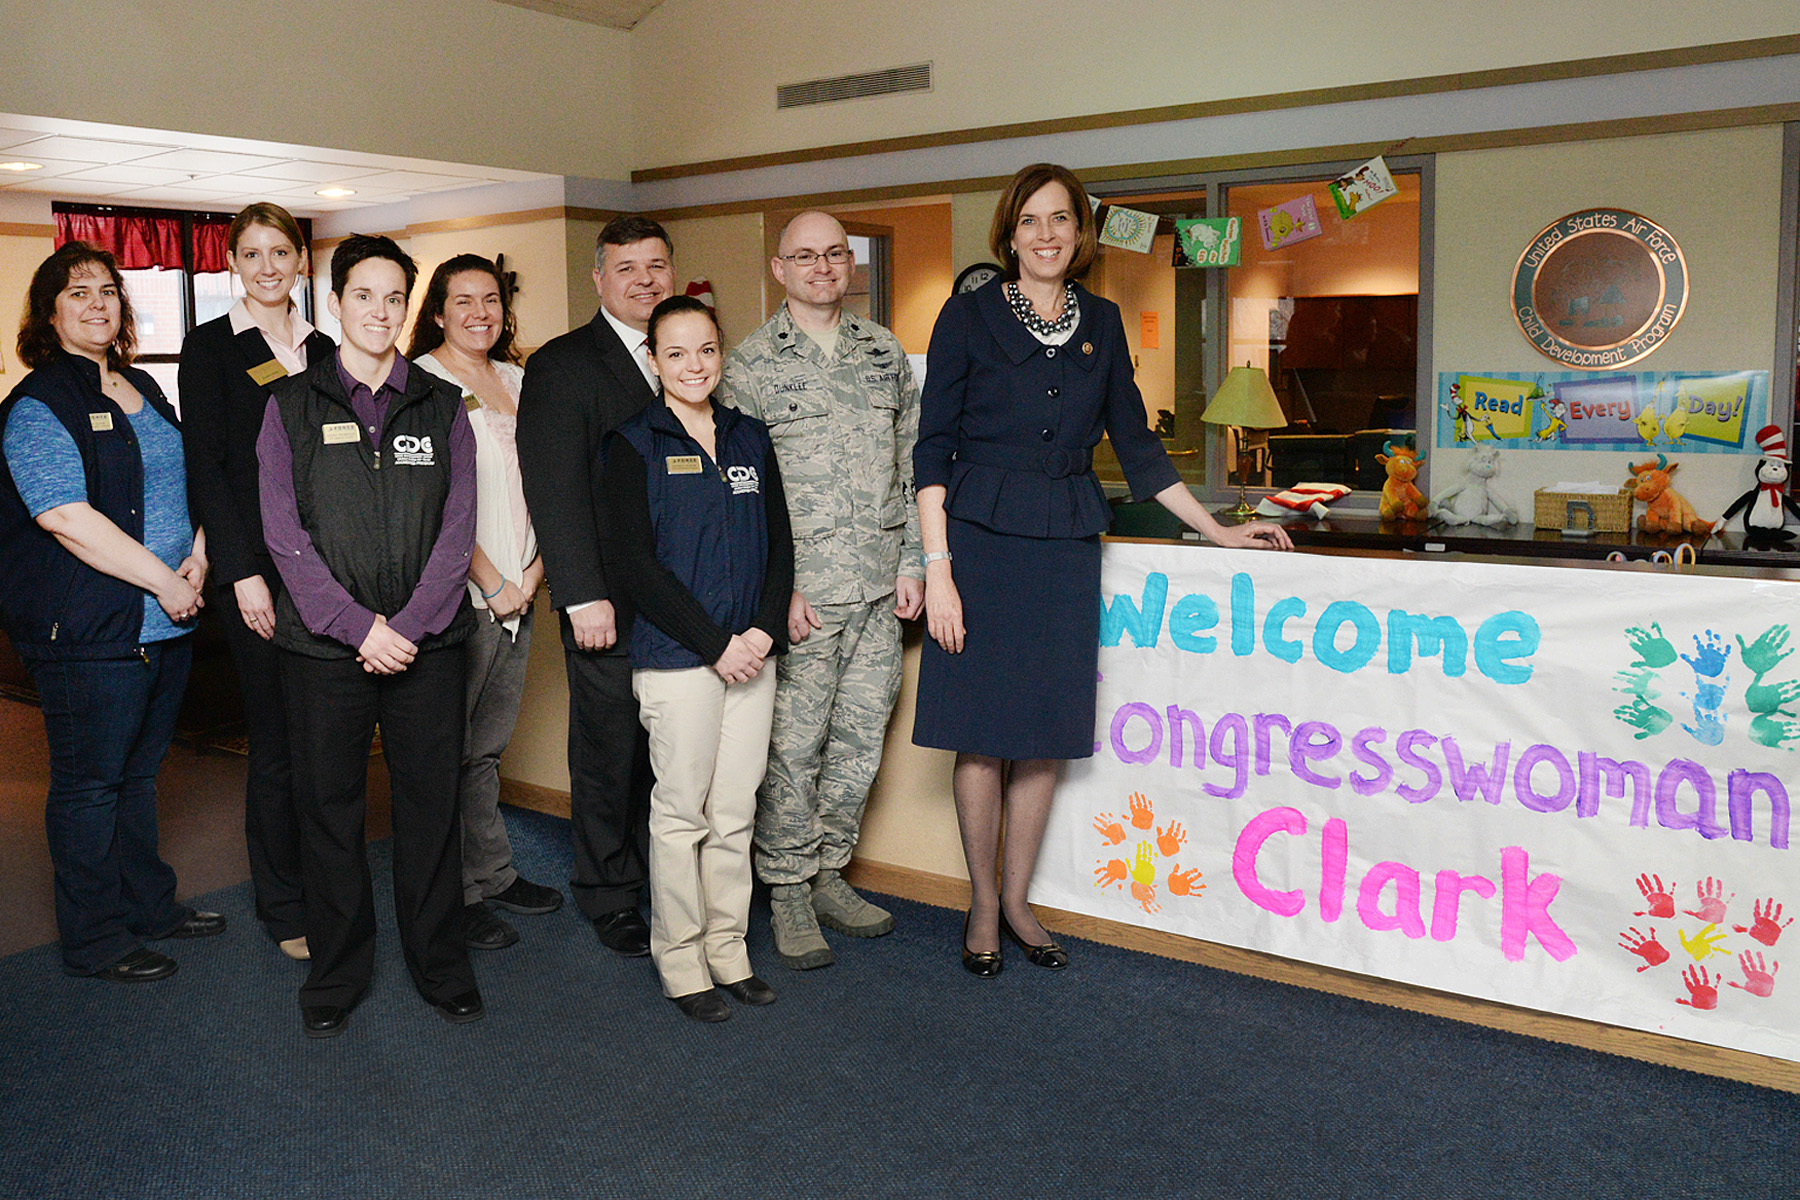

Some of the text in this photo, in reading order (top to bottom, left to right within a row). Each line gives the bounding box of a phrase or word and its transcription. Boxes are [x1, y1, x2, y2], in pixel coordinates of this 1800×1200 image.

[1524, 213, 1677, 268] United States Air Force
[1518, 303, 1678, 366] Child Development Program
[1474, 391, 1744, 423] Read Every Day!
[1098, 572, 1542, 686] Welcome
[1094, 680, 1791, 851] ongresswoman
[1231, 806, 1578, 963] Clark
